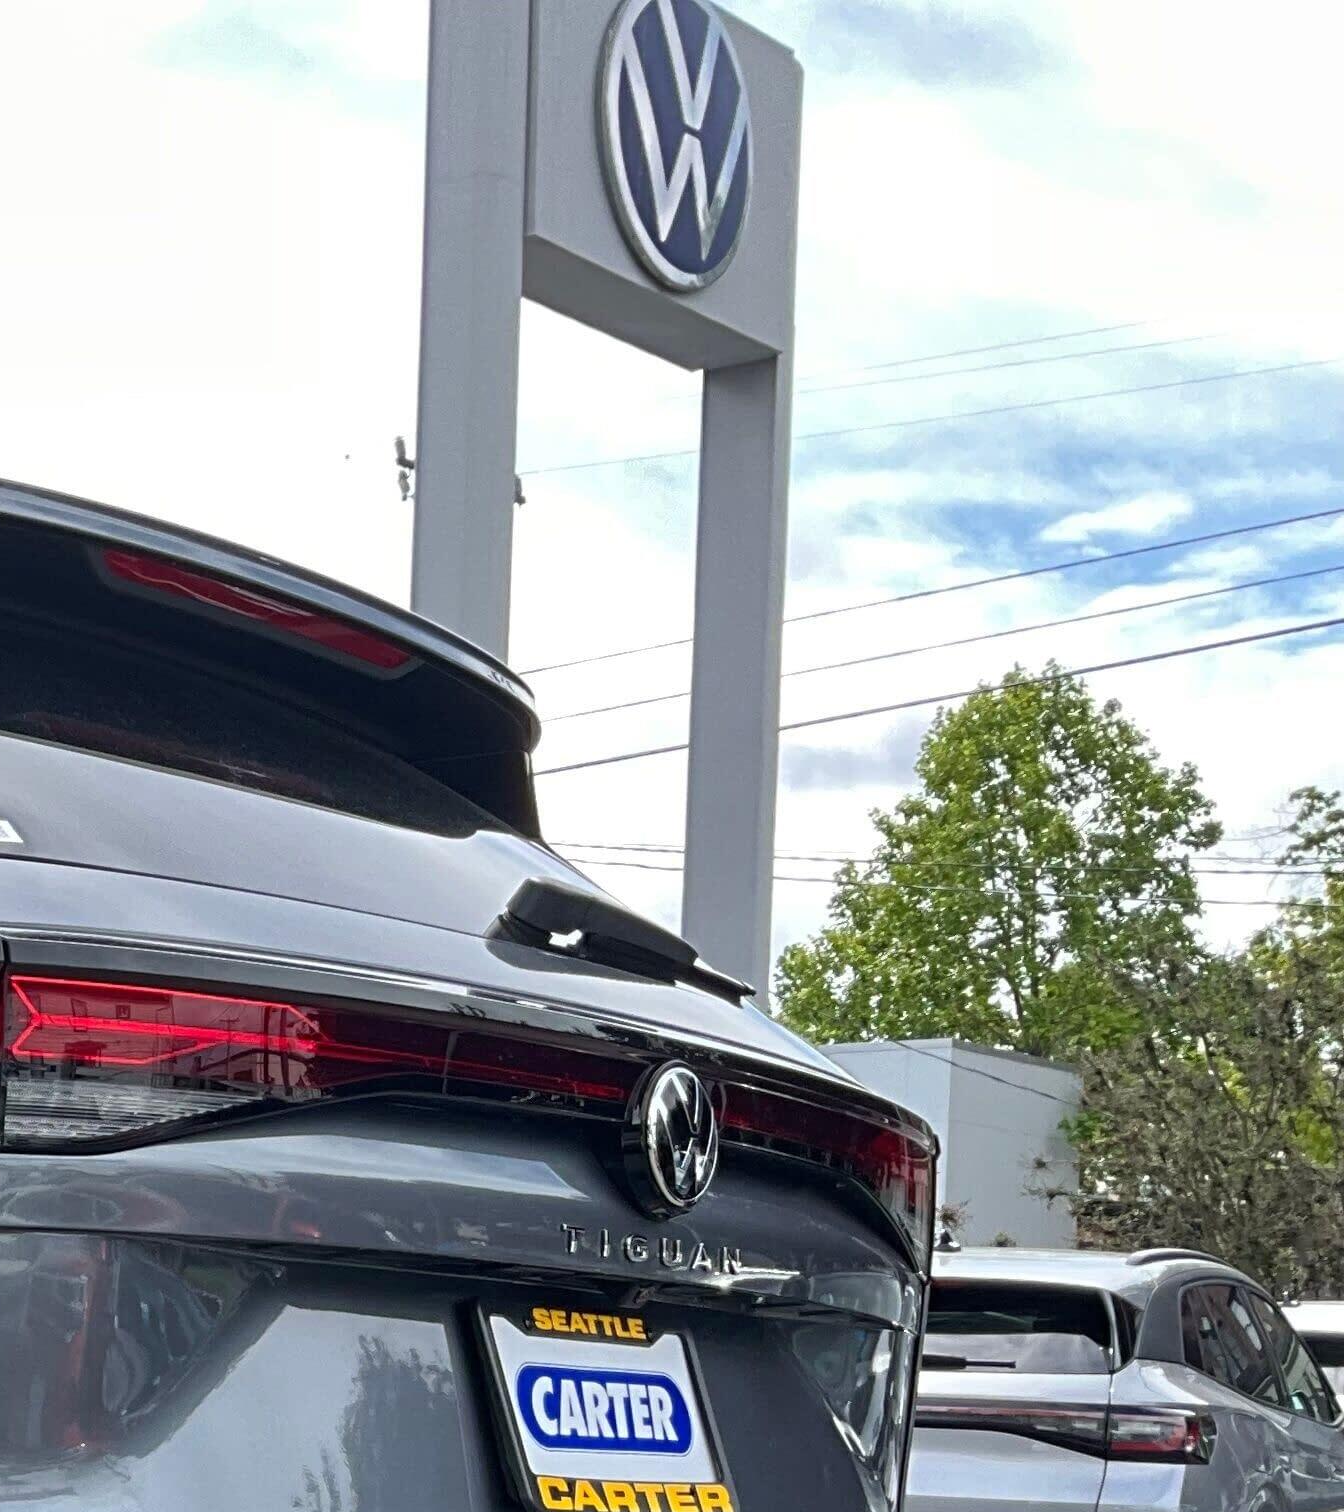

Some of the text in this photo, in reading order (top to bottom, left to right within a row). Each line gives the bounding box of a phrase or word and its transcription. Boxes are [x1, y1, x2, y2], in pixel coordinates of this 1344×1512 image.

[615, 0, 750, 264] VW
[560, 1224, 744, 1275] TIGUAN
[530, 1307, 648, 1341] SEATTLE
[531, 1375, 679, 1442] CARTER
